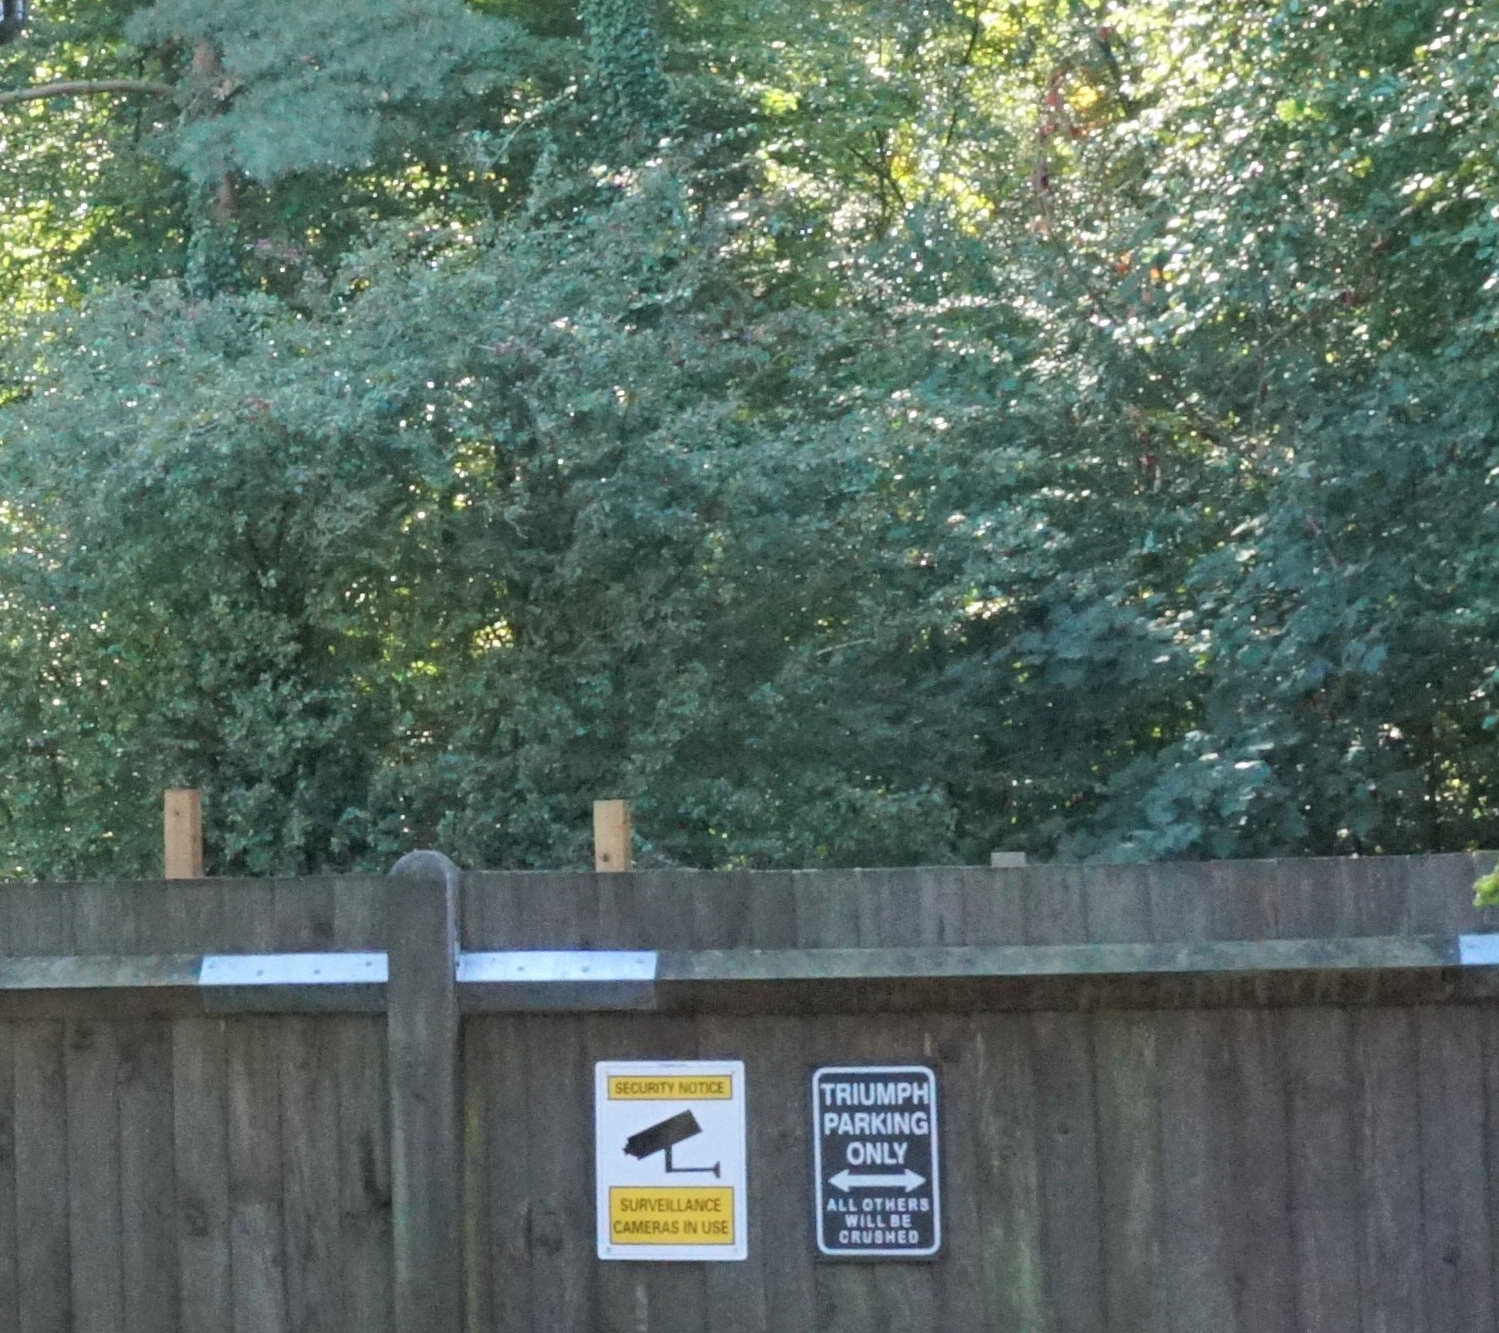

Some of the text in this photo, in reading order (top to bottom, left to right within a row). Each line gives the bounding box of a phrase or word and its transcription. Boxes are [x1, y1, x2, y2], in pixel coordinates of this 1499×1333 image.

[614, 1081, 725, 1095] SECURITY NOTICE
[820, 1081, 930, 1106] TRIUMPH
[823, 1111, 929, 1136] PARKING
[846, 1141, 908, 1165] ONLY
[620, 1197, 722, 1213] SURVEILLANCE
[826, 1197, 930, 1212] ALL OTHERS
[612, 1219, 730, 1235] CAMERAS IN USE
[844, 1213, 913, 1228] WILL BE
[838, 1229, 920, 1244] CRUSHED
